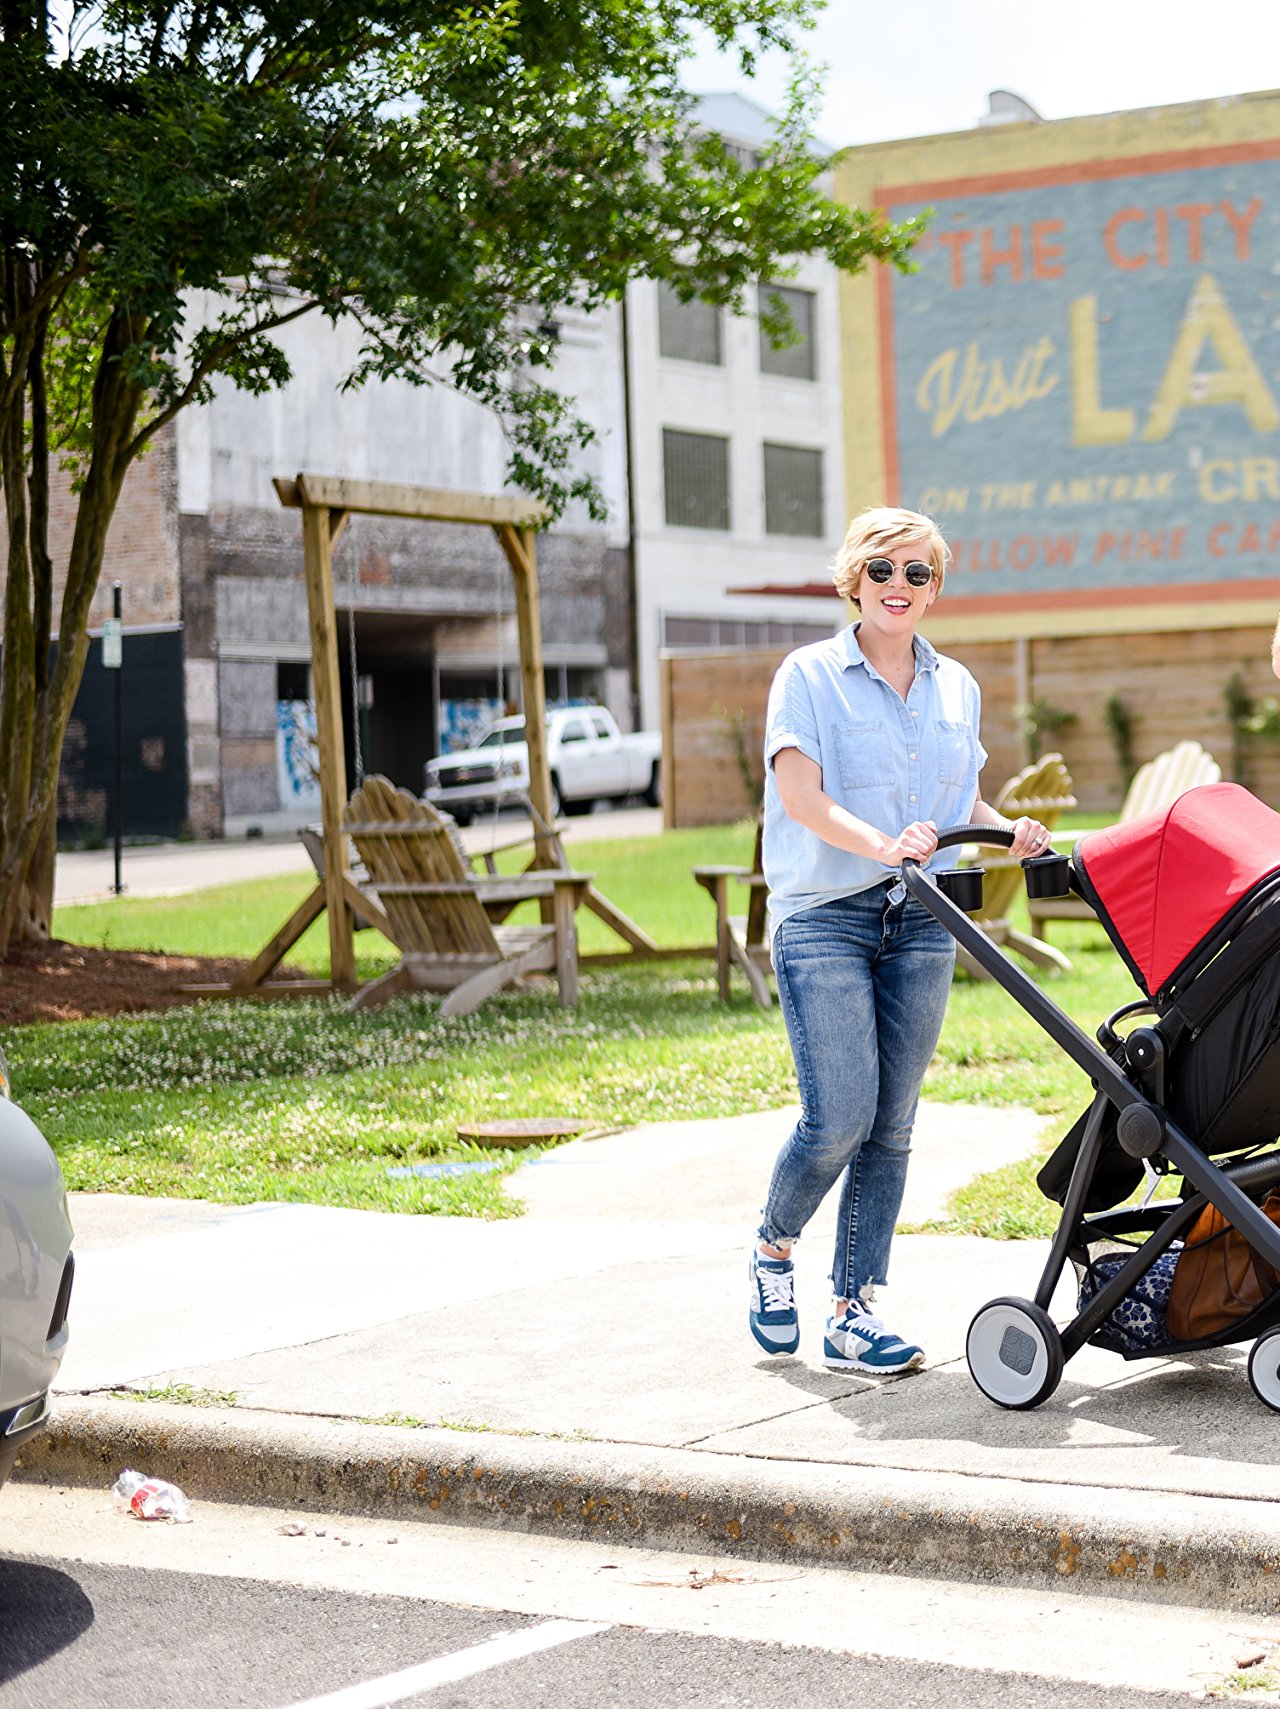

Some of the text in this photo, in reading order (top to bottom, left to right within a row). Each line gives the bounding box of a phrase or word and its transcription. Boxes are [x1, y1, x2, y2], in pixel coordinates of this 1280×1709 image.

[1104, 199, 1264, 271] CITY
[917, 336, 1061, 437] Visit
[919, 486, 970, 514] ON
[979, 480, 1037, 513] THE
[1044, 470, 1177, 509] AMTRAK
[950, 531, 1080, 575] ELLOW
[1092, 523, 1189, 564] PINE
